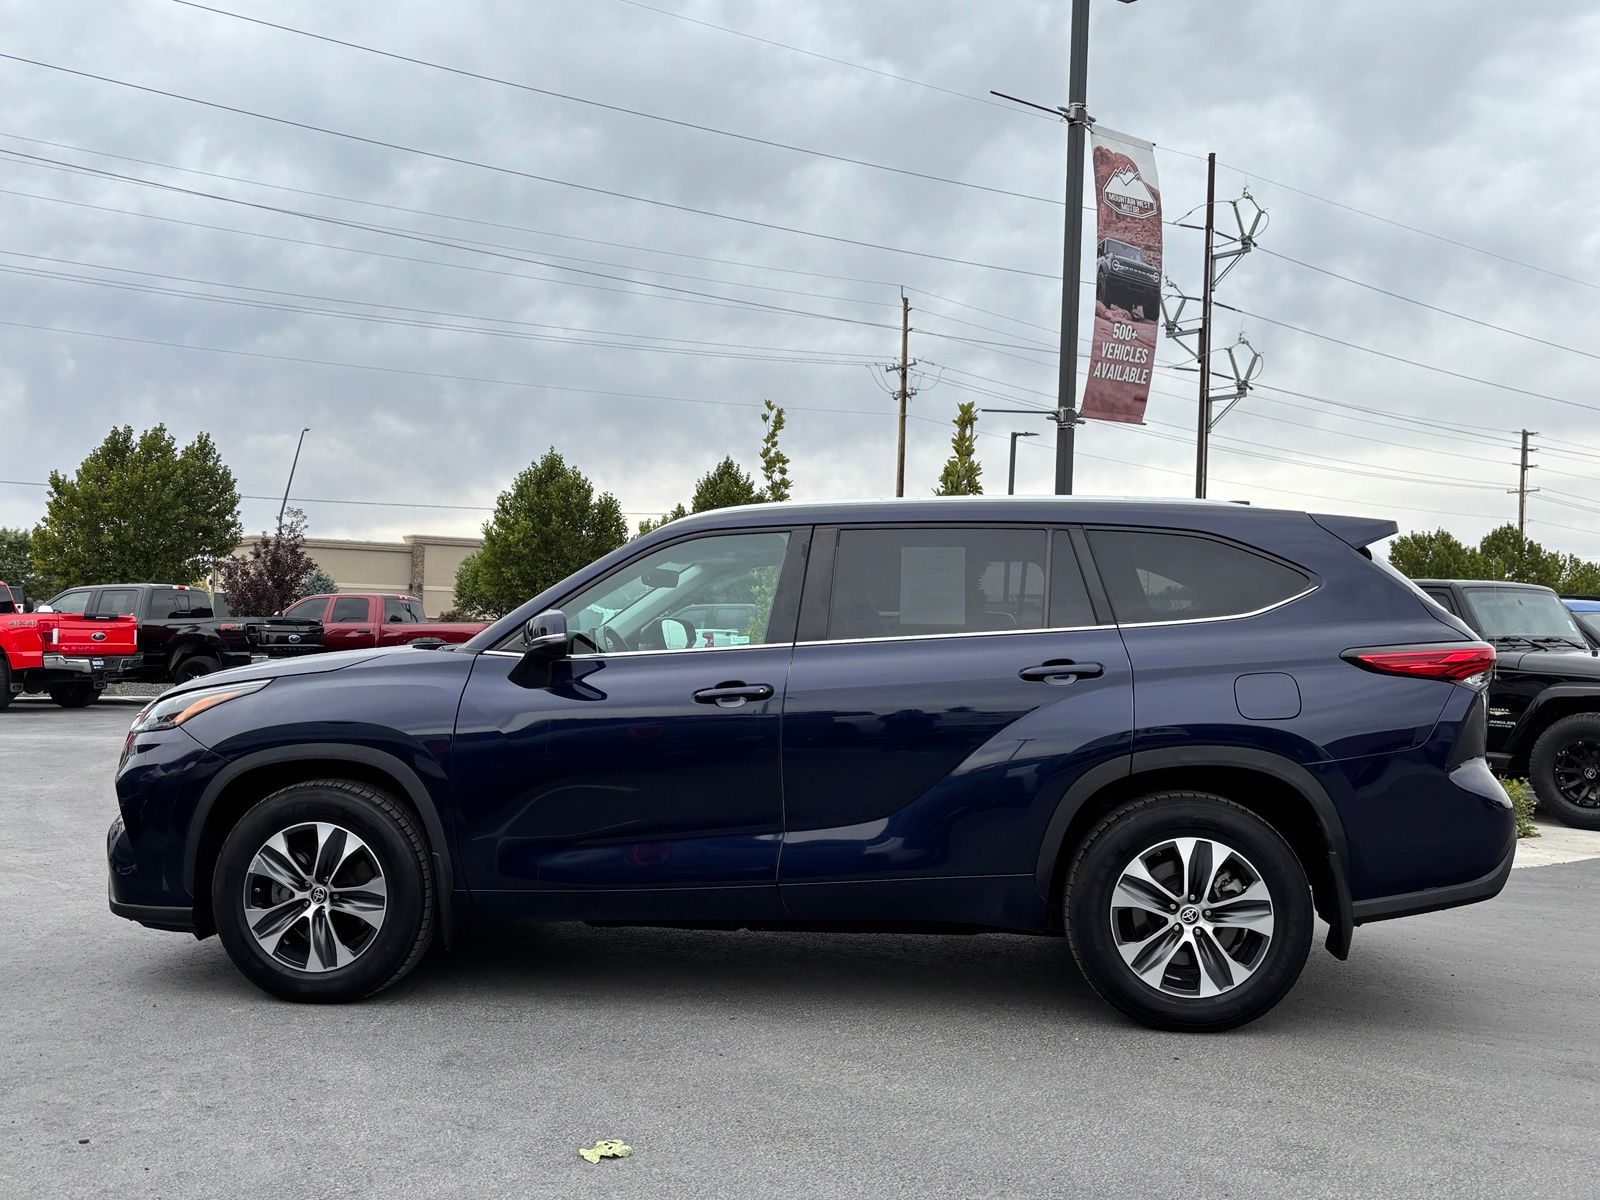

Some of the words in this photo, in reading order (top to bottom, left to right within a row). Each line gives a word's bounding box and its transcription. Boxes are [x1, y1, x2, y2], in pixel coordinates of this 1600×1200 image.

[1108, 193, 1136, 205] MOUNTAIN
[1136, 200, 1151, 209] WEST
[1112, 322, 1137, 340] 500+
[1101, 342, 1148, 364] VEHICLES
[1093, 362, 1149, 384] AVAILABLE
